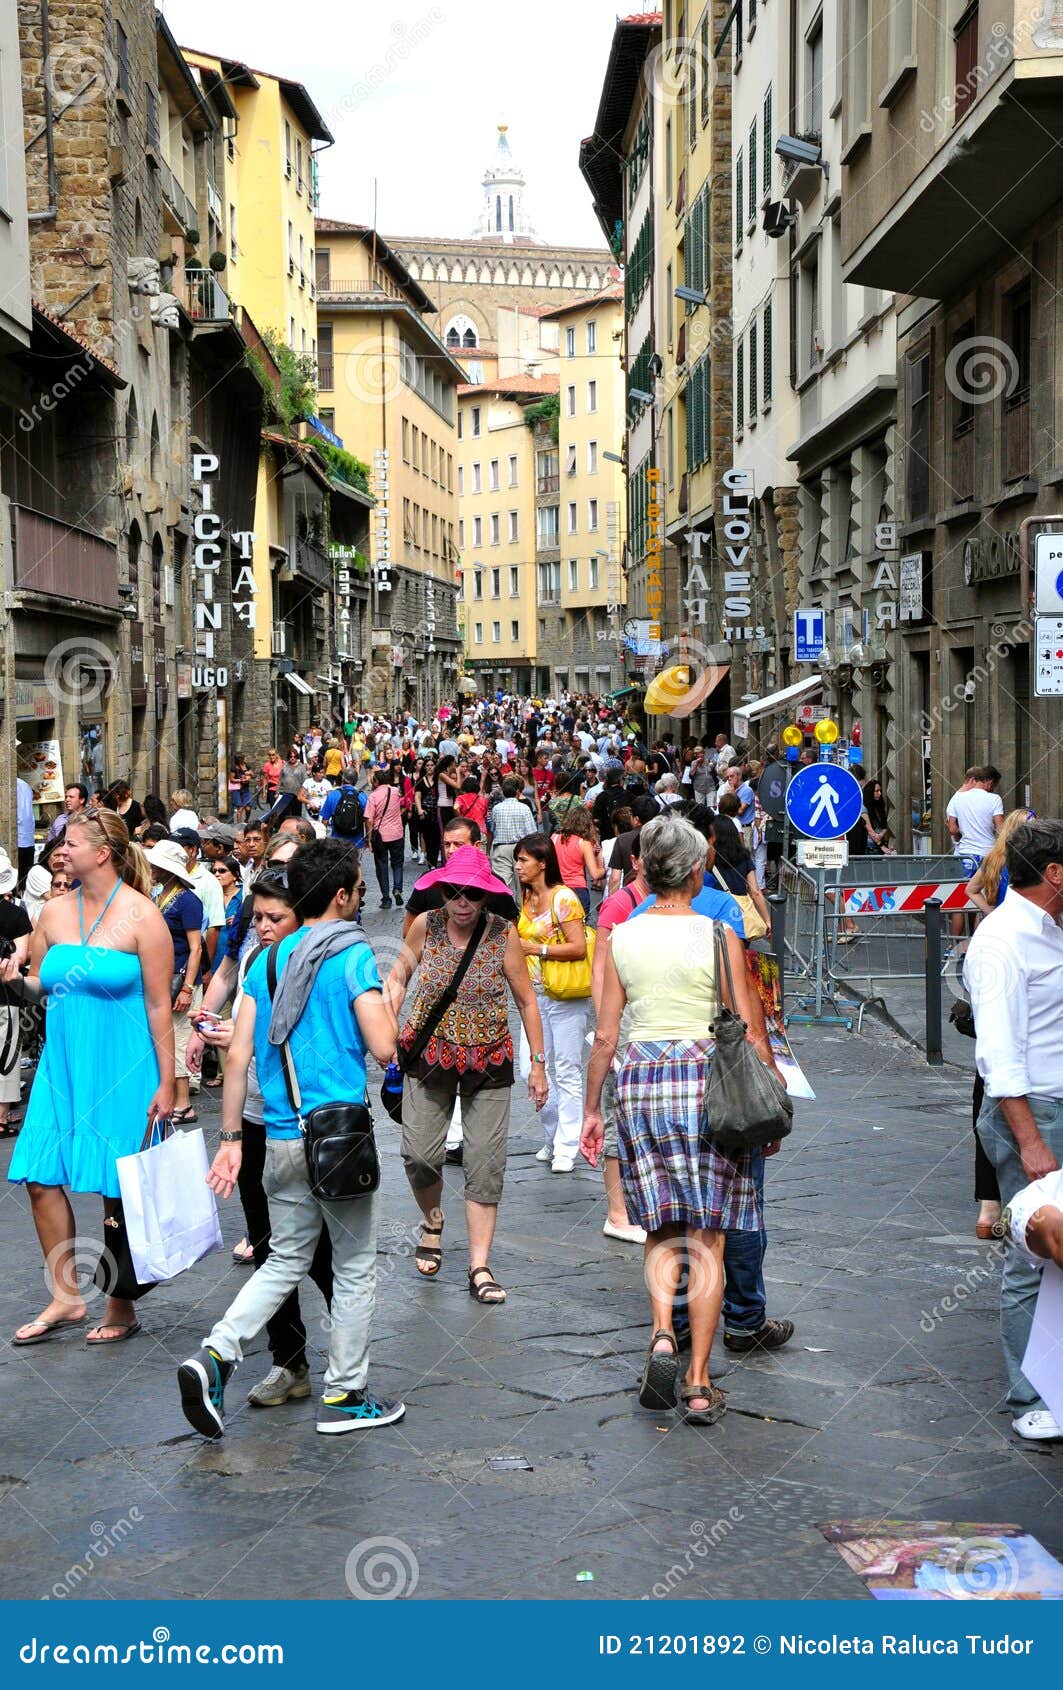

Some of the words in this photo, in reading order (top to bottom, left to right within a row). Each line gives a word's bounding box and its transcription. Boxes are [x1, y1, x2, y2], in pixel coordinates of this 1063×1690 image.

[723, 469, 751, 617] GLOVES
[193, 454, 221, 659] PICCINI
[724, 626, 765, 640] TIES
[191, 667, 228, 687] UGO
[850, 890, 896, 911] SAS
